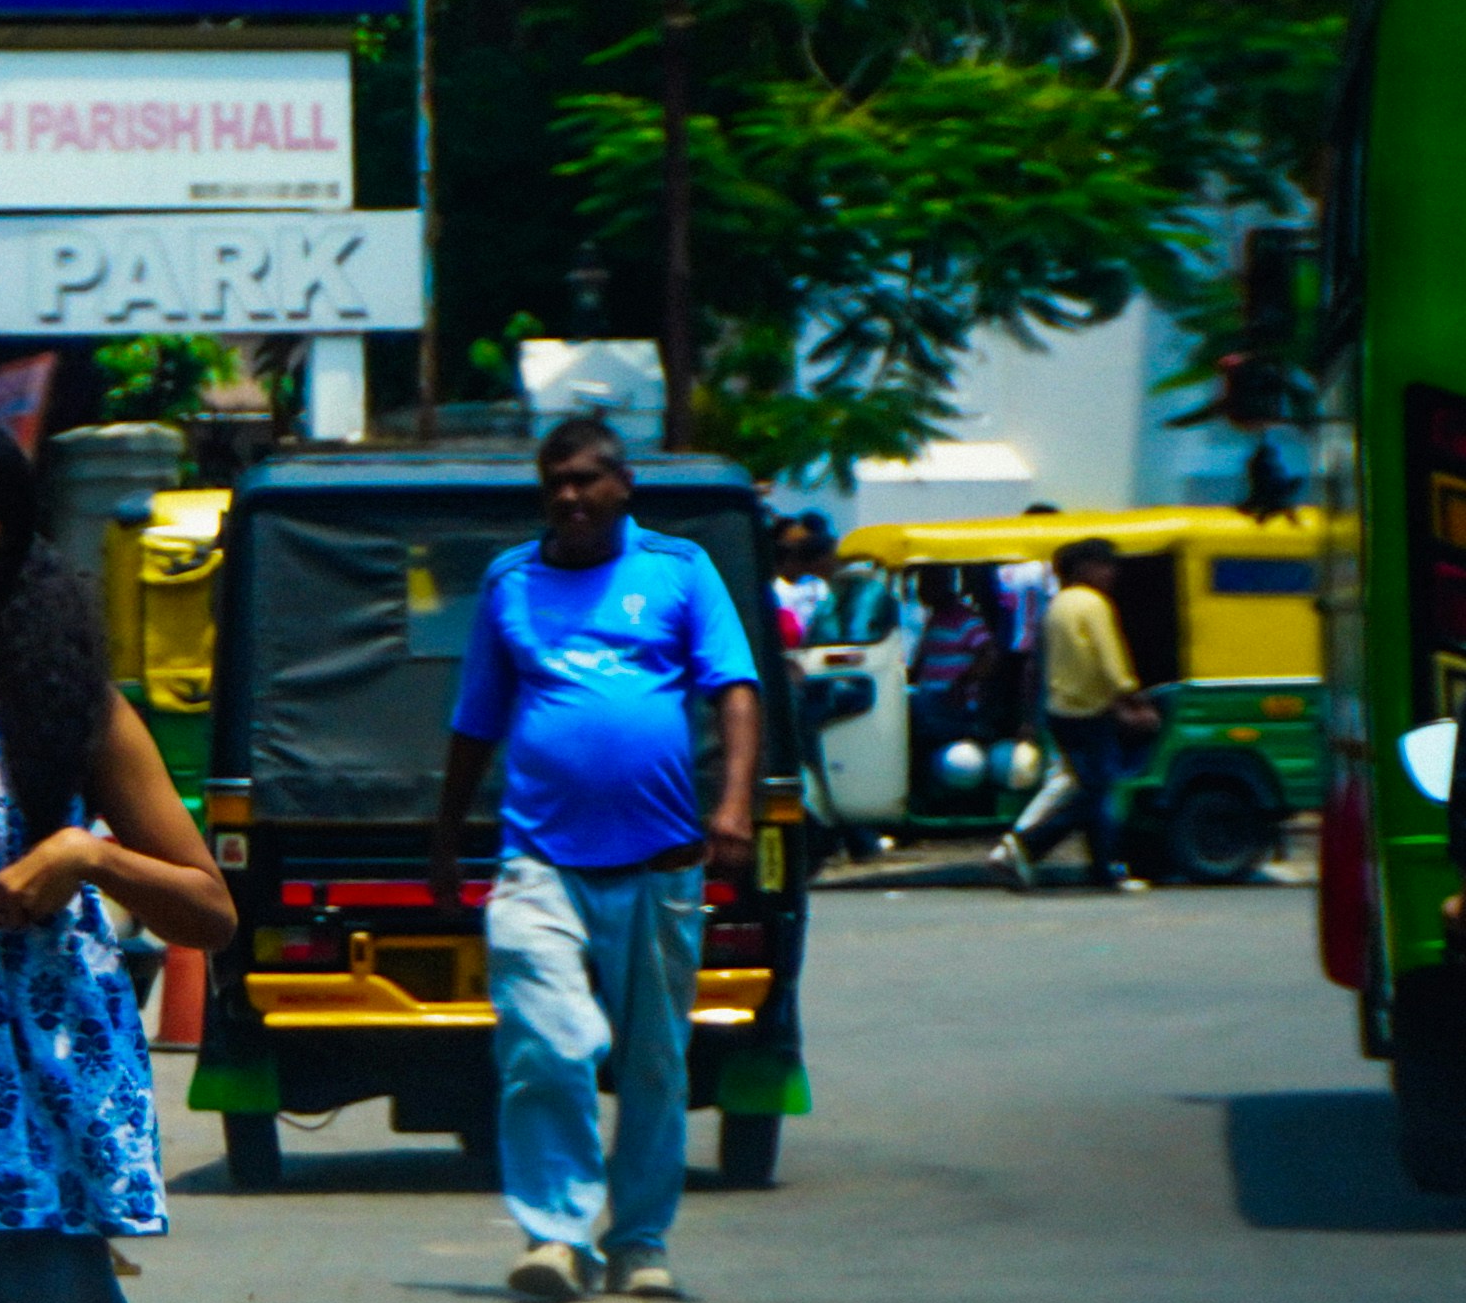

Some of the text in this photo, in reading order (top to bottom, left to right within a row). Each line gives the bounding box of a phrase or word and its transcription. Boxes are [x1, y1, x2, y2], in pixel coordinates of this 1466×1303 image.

[27, 101, 200, 152] PARISH
[211, 101, 338, 151] HALL
[32, 224, 370, 324] PARK
